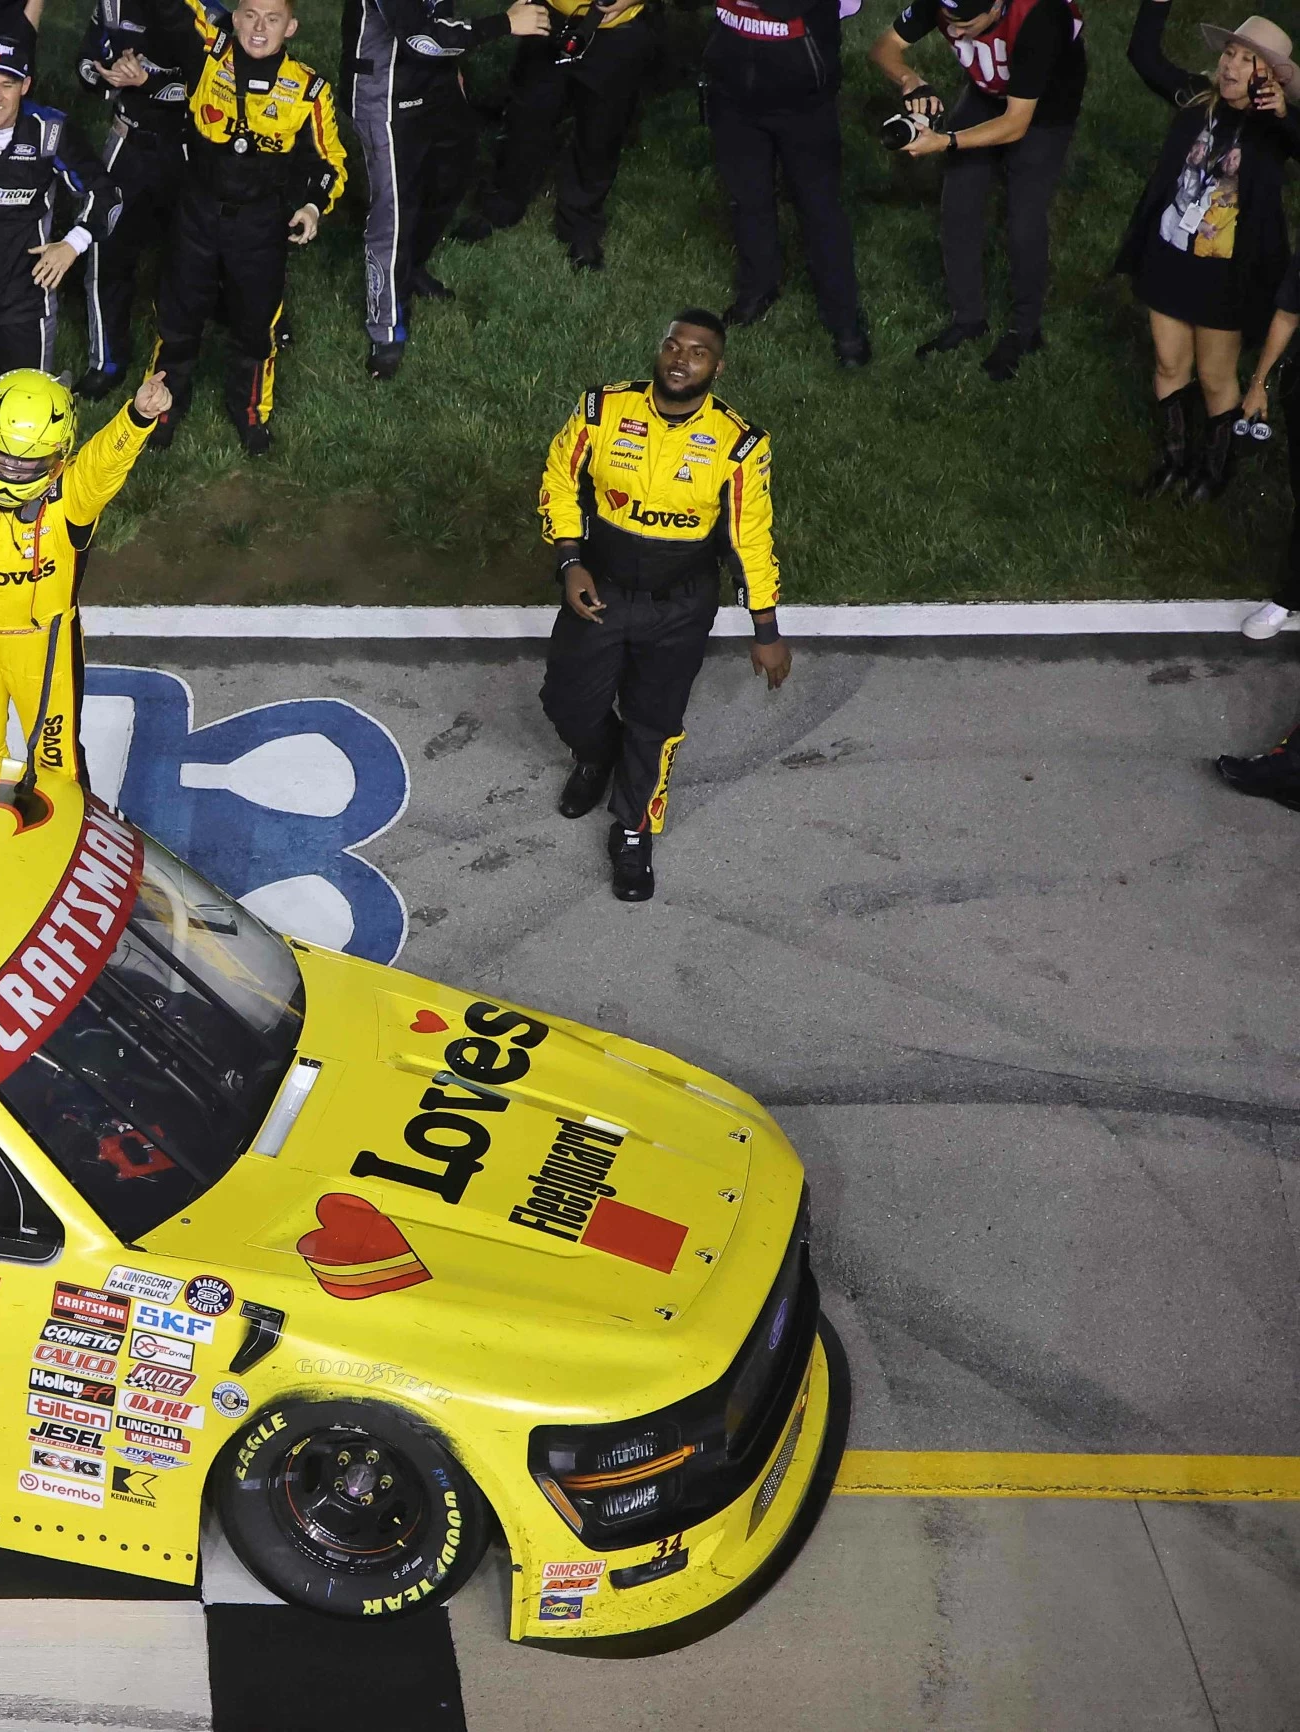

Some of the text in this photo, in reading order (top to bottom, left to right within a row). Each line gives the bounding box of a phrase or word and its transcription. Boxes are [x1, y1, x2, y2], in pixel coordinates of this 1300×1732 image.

[716, 6, 789, 37] TEAM/DRIVER
[508, 1117, 627, 1243] Fleetguard
[109, 1280, 171, 1300] RACE TRUCK
[130, 1272, 173, 1291] NASCAR
[195, 1279, 230, 1296] NASCAR
[84, 1290, 109, 1301] NASCAR
[189, 1296, 225, 1314] SALUTES
[198, 1290, 220, 1301] 250
[57, 1296, 125, 1319] CRAFTSMAN
[137, 1305, 211, 1336] SKF
[44, 1325, 121, 1351] COMETIC
[35, 1345, 117, 1375] CALICO
[30, 1368, 83, 1398] Holley
[135, 1366, 191, 1391] KLOTZ
[295, 1358, 452, 1404] GOODYEAR
[216, 1382, 246, 1398] CHAMPION
[34, 1399, 105, 1427] tilton
[129, 1394, 199, 1420] DART
[30, 1422, 105, 1450] JESEL
[119, 1417, 178, 1439] LINCOLN
[131, 1433, 183, 1451] WELDERS
[235, 1411, 288, 1480] EAGLE
[125, 1447, 176, 1463] FIVE STAR
[42, 1480, 101, 1502] brembo
[111, 1492, 156, 1508] KENNAMETAL
[651, 1532, 683, 1562] 34
[545, 1562, 602, 1577] SIMPSON
[543, 1578, 598, 1590] ARP
